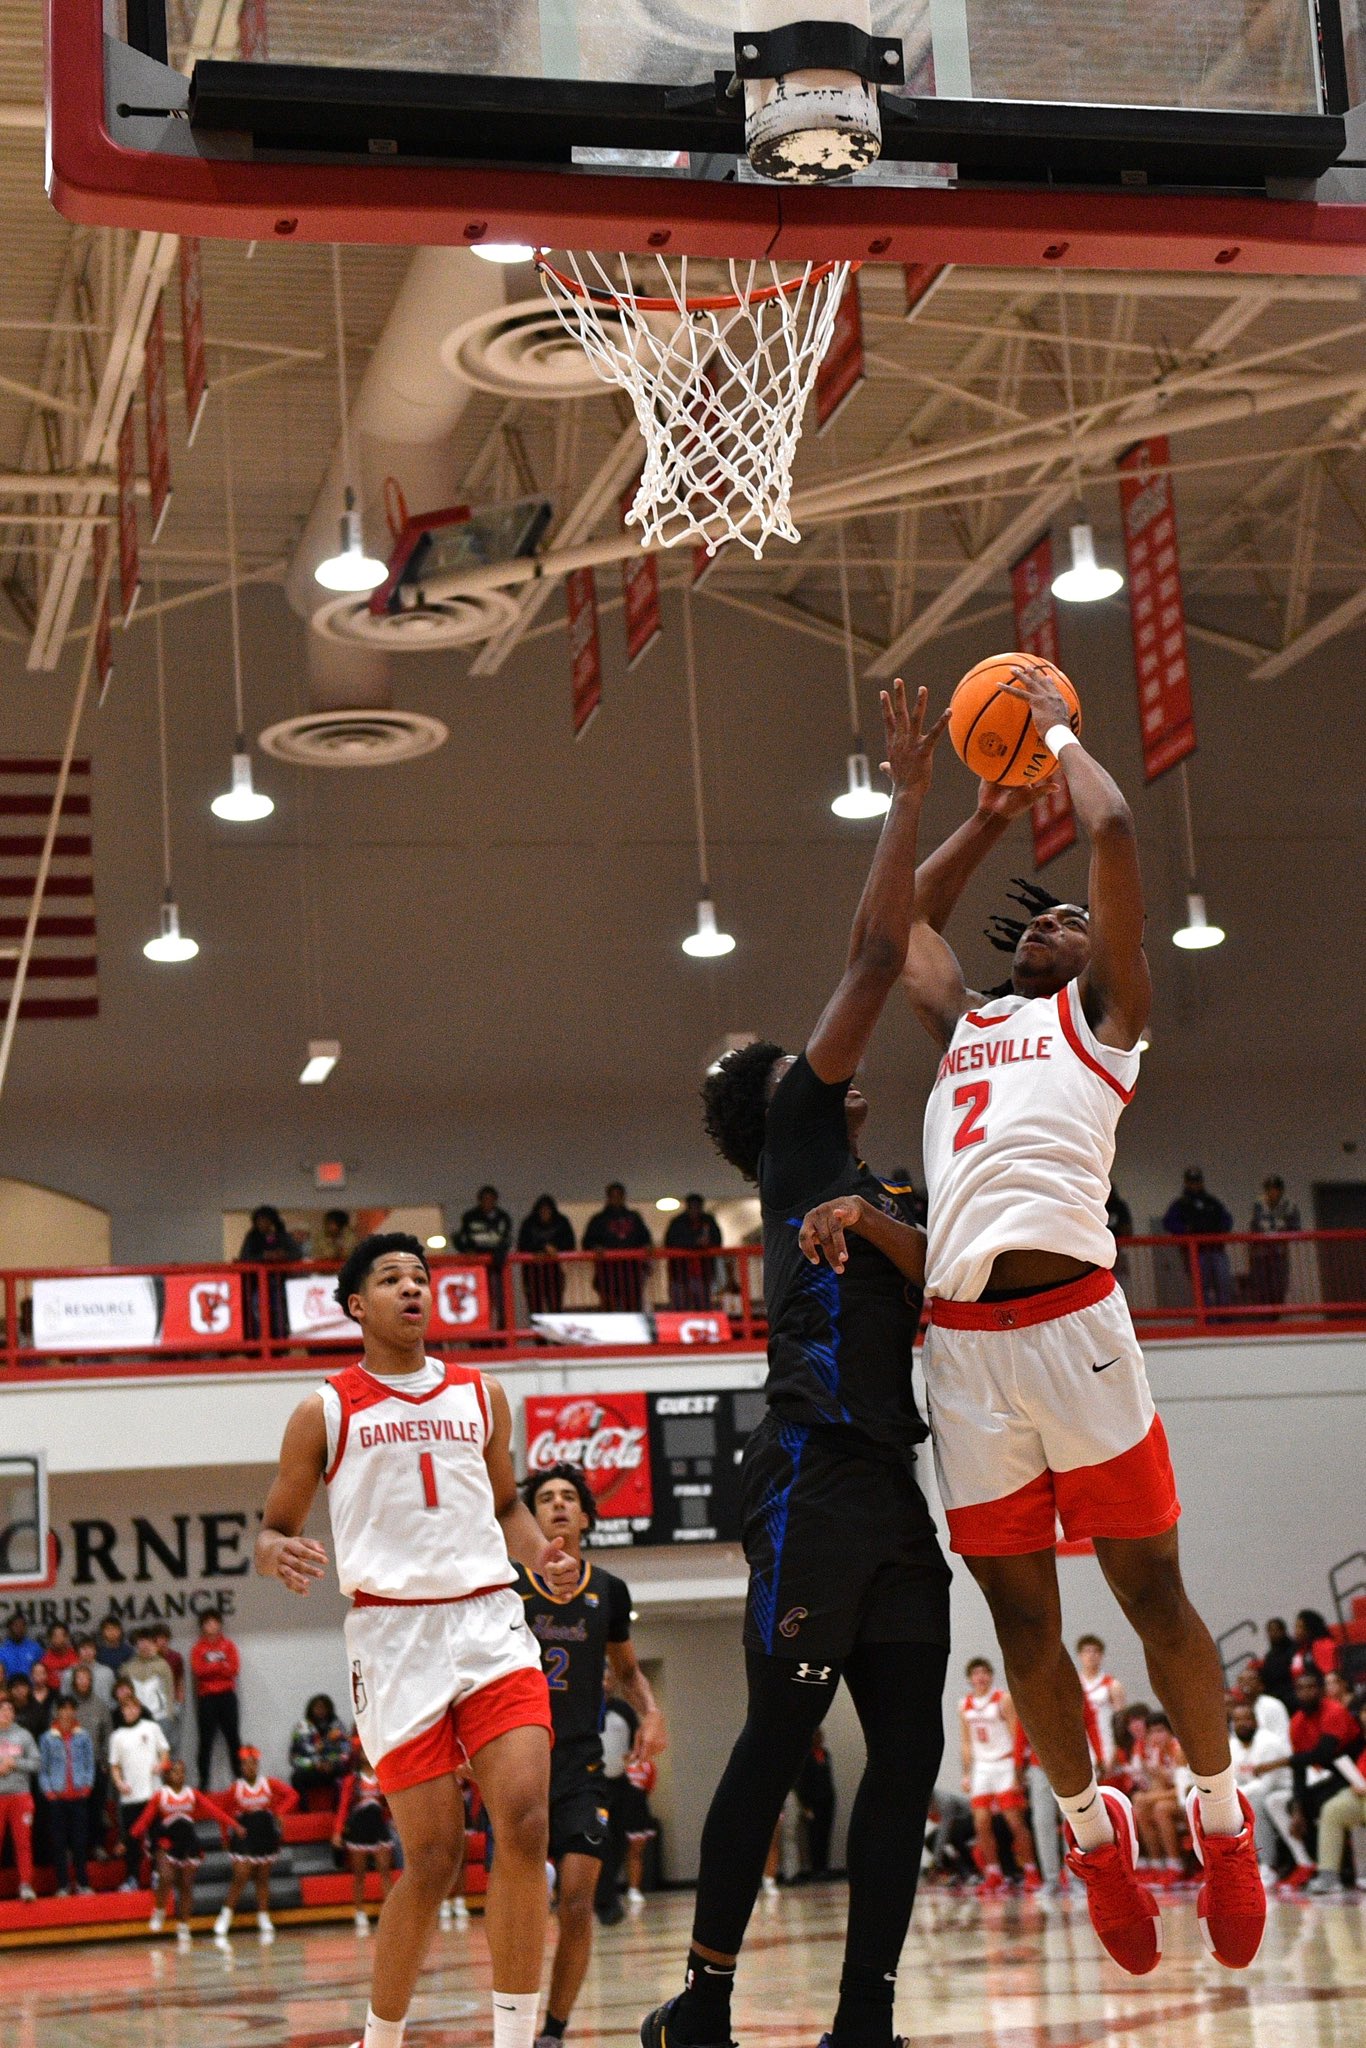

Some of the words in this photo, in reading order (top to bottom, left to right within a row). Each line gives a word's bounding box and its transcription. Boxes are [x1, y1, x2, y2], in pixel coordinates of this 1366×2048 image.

[952, 1079, 992, 1156] 2
[359, 1419, 479, 1448] GAINESVILLE
[418, 1451, 440, 1510] 1
[779, 1606, 808, 1638] C
[544, 1647, 570, 1691] 2
